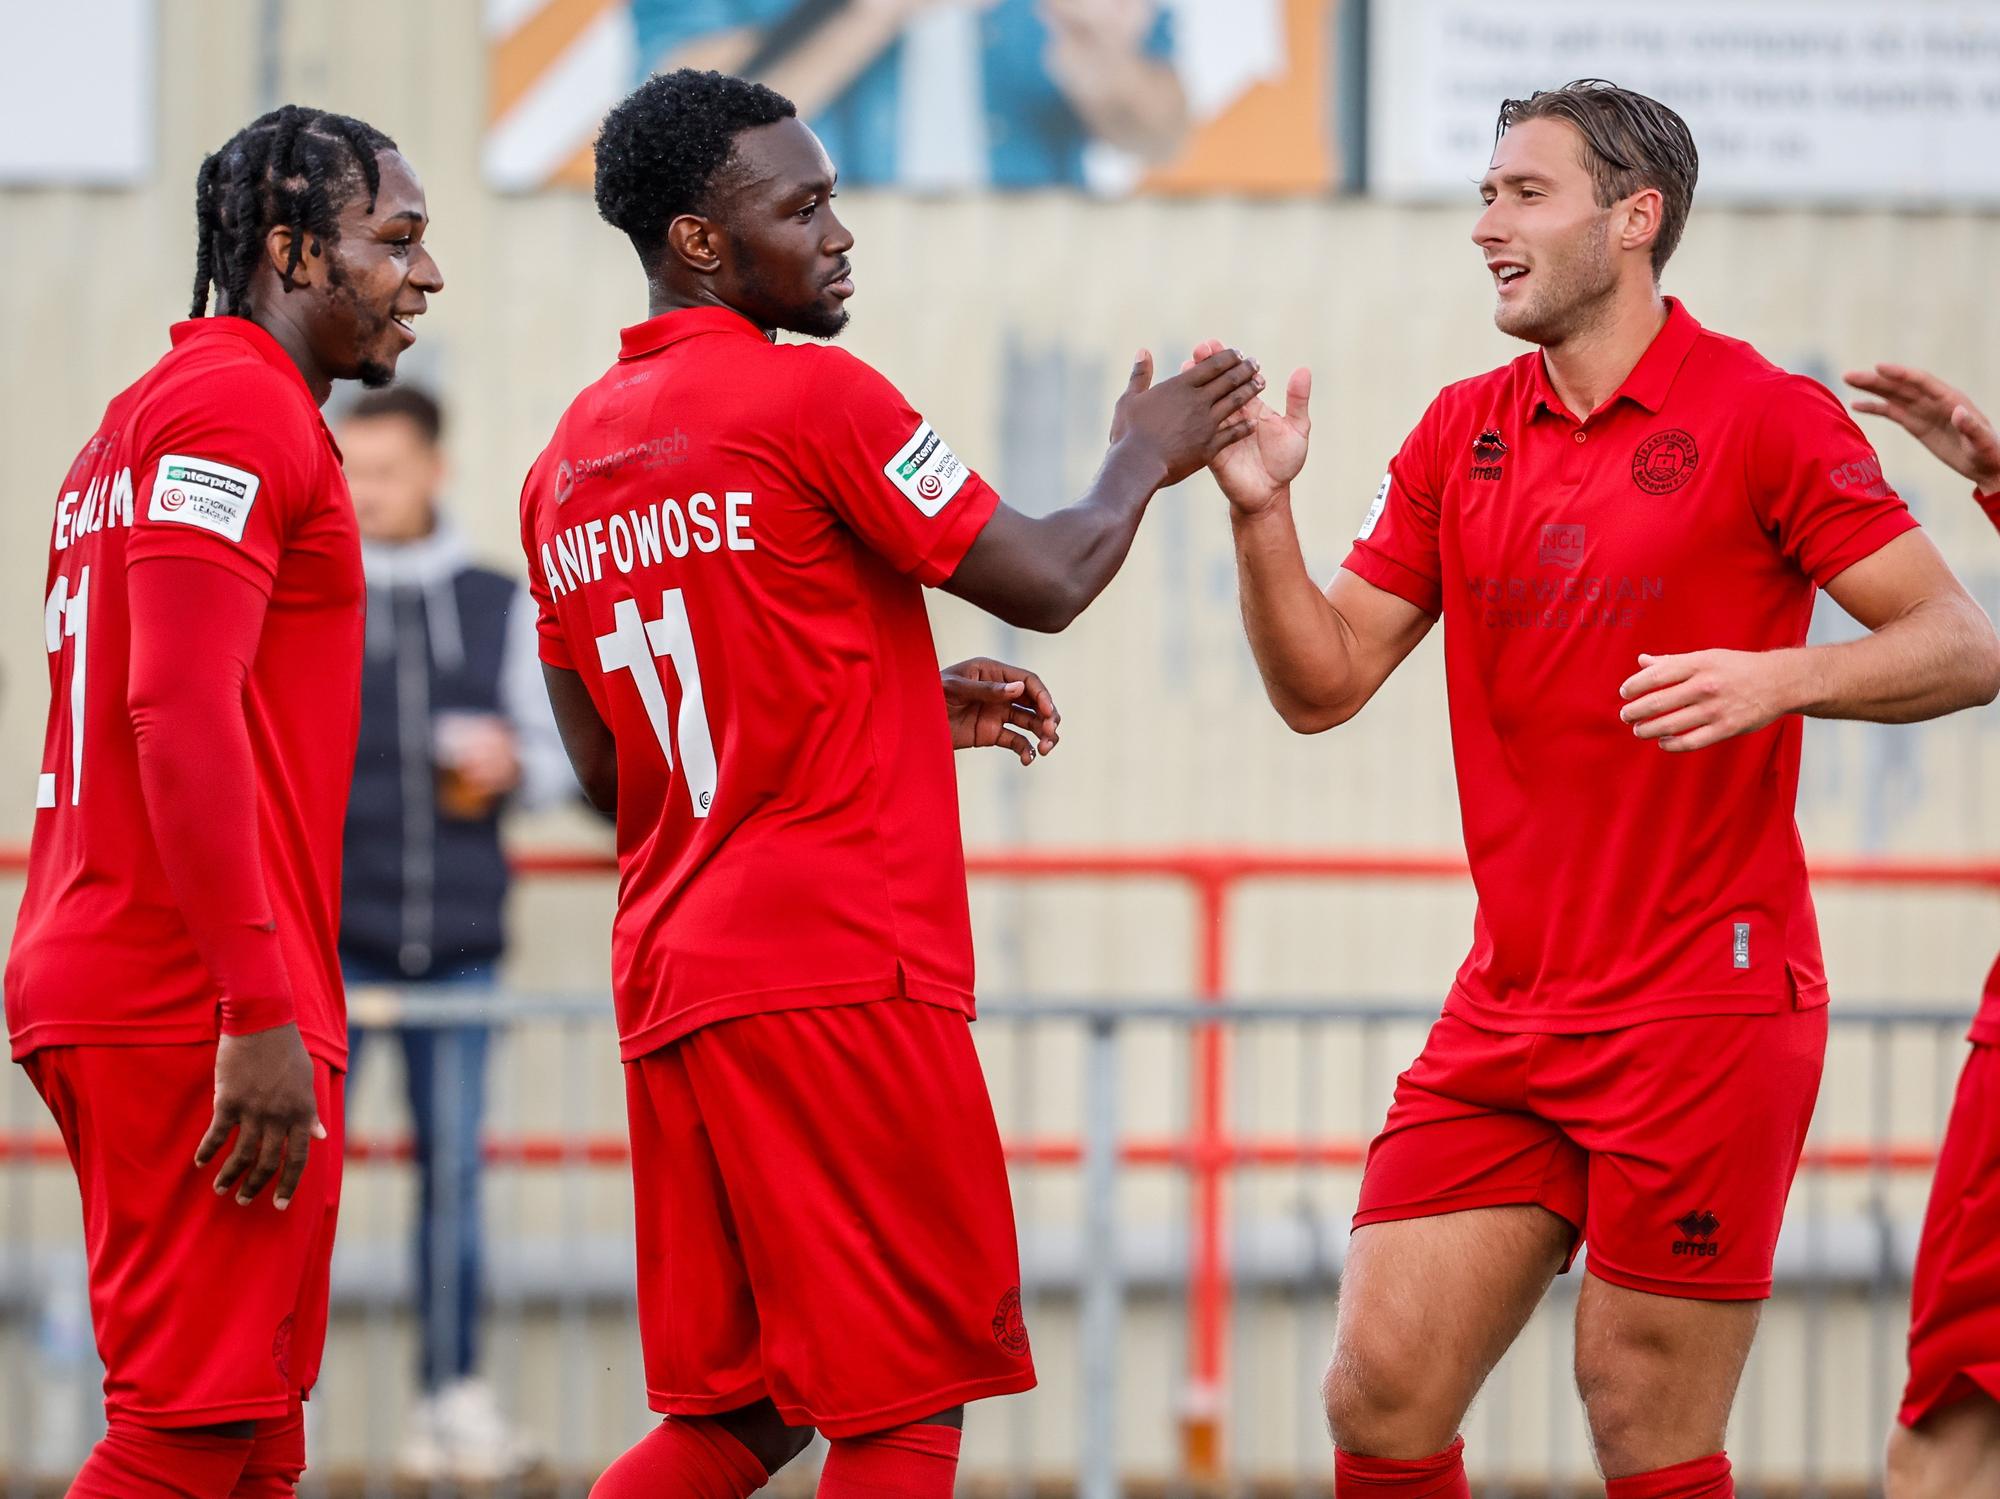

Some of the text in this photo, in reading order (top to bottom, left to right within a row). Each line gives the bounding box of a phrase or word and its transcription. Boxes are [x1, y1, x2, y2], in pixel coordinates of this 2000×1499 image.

[169, 467, 246, 498] enterprise
[541, 491, 755, 603] ANIFOWOSE
[1542, 530, 1581, 550] NCL
[1466, 576, 1664, 602] NORWEGIAN
[1485, 609, 1569, 629] CRUISE
[596, 588, 718, 818] 11
